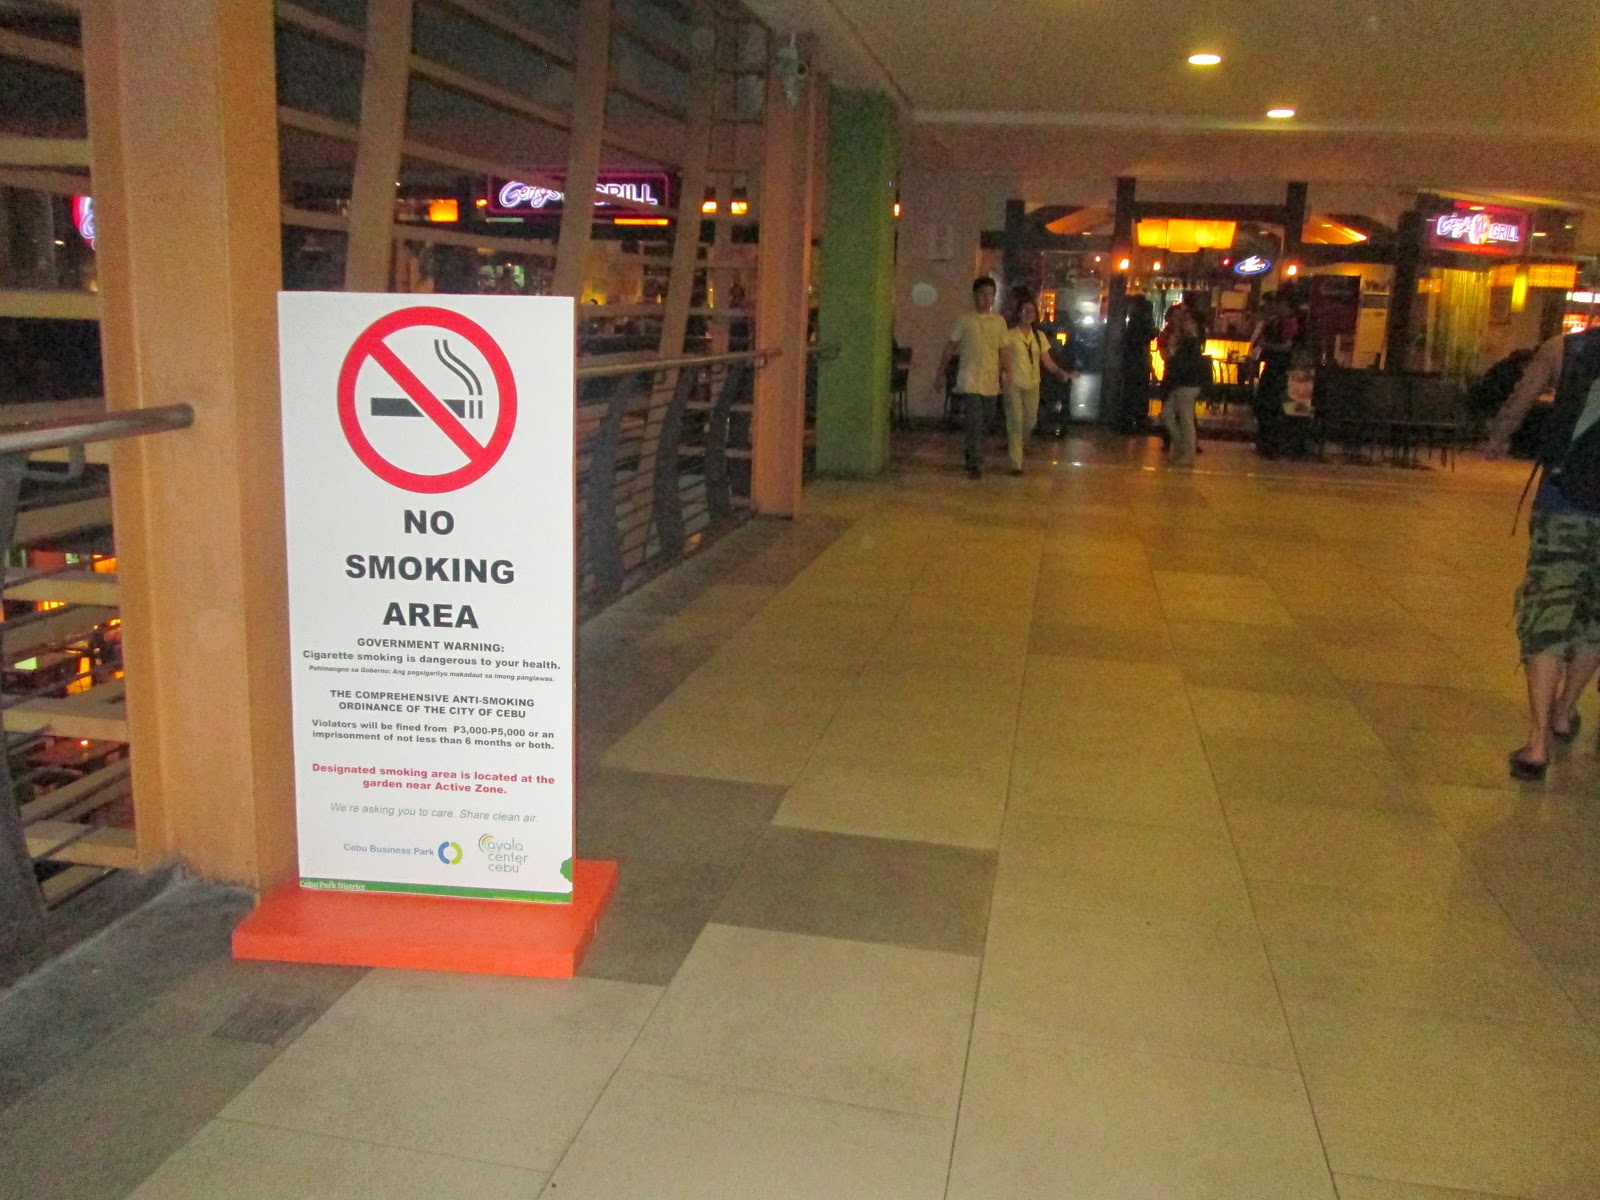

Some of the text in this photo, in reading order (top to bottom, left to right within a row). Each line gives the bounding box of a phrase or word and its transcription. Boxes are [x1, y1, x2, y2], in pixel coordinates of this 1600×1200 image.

[1489, 223, 1520, 242] GRILL
[403, 509, 455, 536] NO
[345, 553, 515, 585] SMOKING
[382, 602, 479, 629] AREA
[357, 637, 505, 653] GOVERNMENT WARNING:
[302, 650, 561, 670] Cigarette smoking is dangerous to your health.
[392, 668, 405, 677] Ang
[329, 689, 535, 707] THE COMPREHENSIVE ANTI-SMOKING
[338, 701, 526, 718] ORDINANCE OF THE CITY OF CEBU
[311, 719, 555, 739] Violators will be fined from P3,000-P5,000 or an
[312, 730, 555, 750] imprisonment of not less than 6 months or both.
[312, 763, 555, 785] Designated smoking area is located at the
[362, 778, 507, 794] garden near Active Zone.
[330, 802, 539, 823] We're asking you to care. Share clean air.
[343, 842, 435, 857] Cebu Business Park
[487, 837, 524, 852] ayala
[487, 851, 529, 863] center
[487, 862, 519, 873] cebu
[299, 880, 366, 891] Cebu Park District
